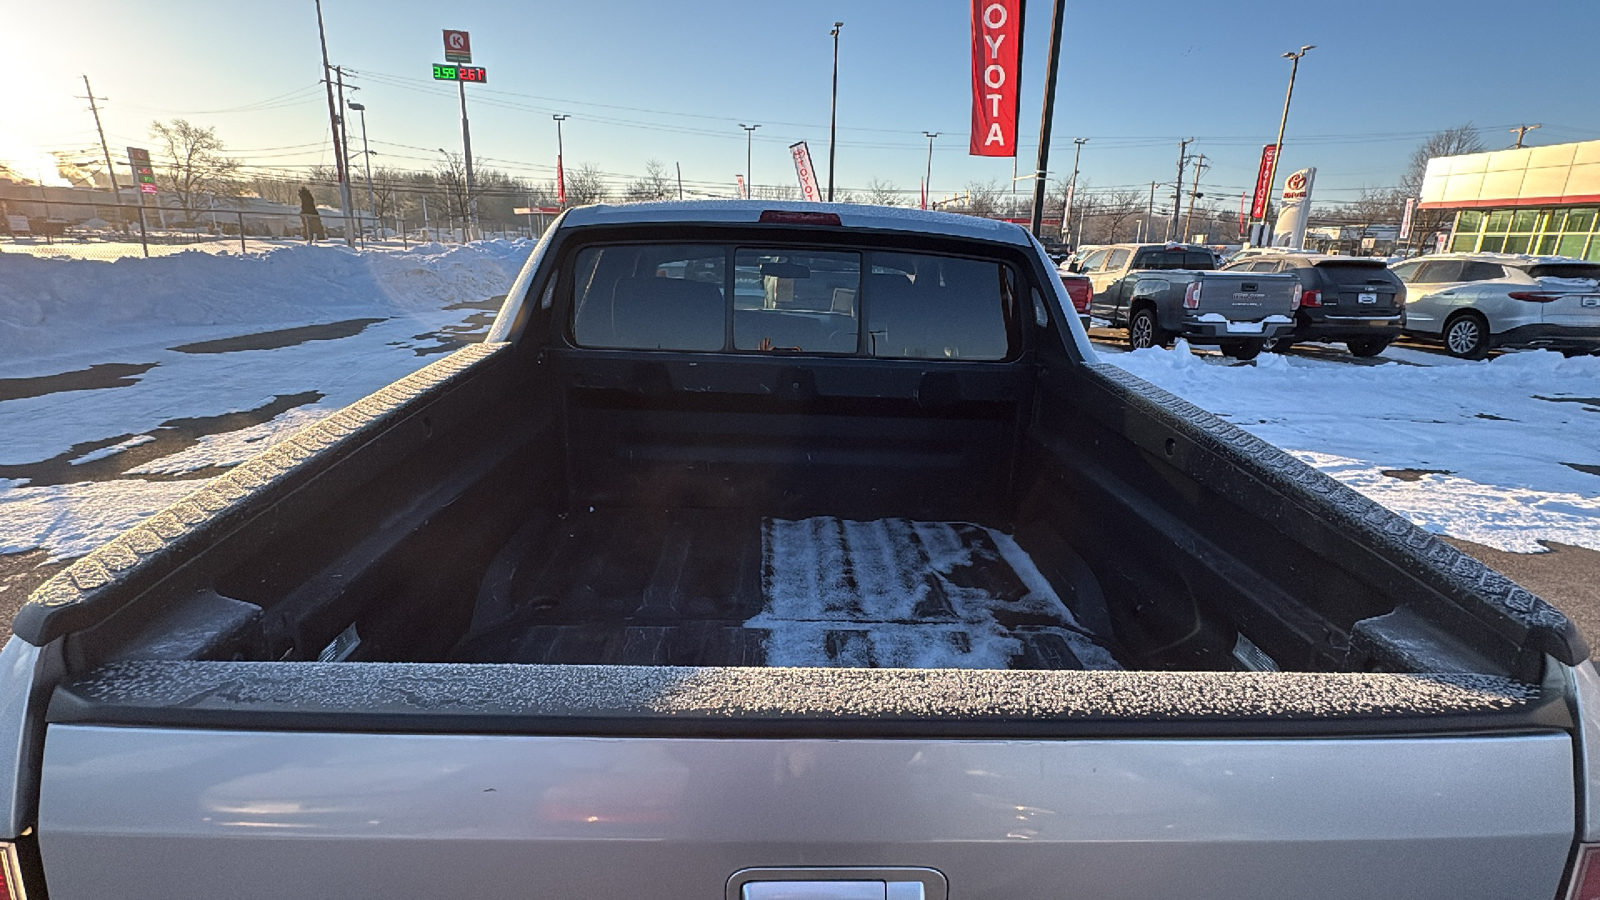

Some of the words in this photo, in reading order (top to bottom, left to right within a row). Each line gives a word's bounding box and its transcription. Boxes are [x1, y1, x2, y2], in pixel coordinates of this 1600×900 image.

[433, 66, 456, 79] 3.59
[983, 3, 1008, 146] OYOTA
[798, 160, 813, 201] TOYOT
